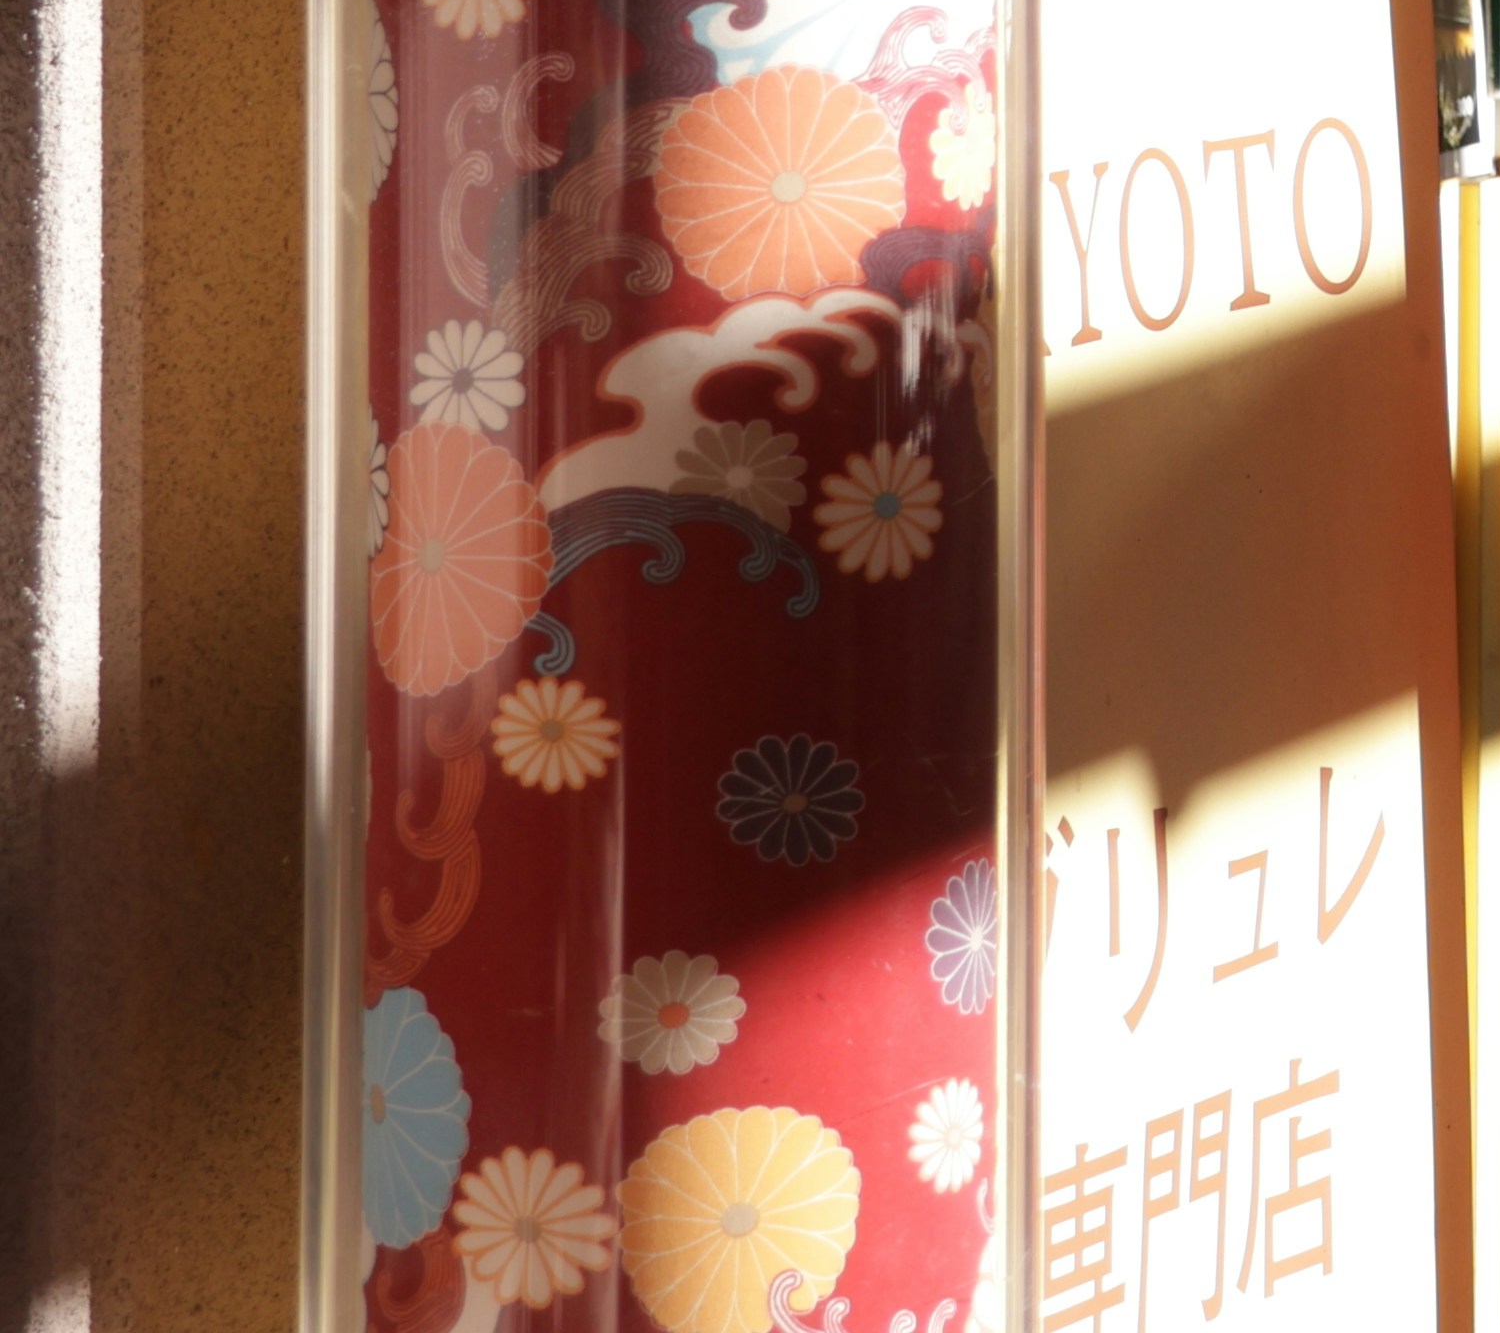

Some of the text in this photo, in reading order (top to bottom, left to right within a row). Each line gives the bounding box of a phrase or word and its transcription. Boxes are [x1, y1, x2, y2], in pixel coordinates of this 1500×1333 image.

[1043, 117, 1373, 357] YOTO
[1046, 767, 1385, 1034] リュレ
[1043, 1057, 1339, 1333] 専門店
